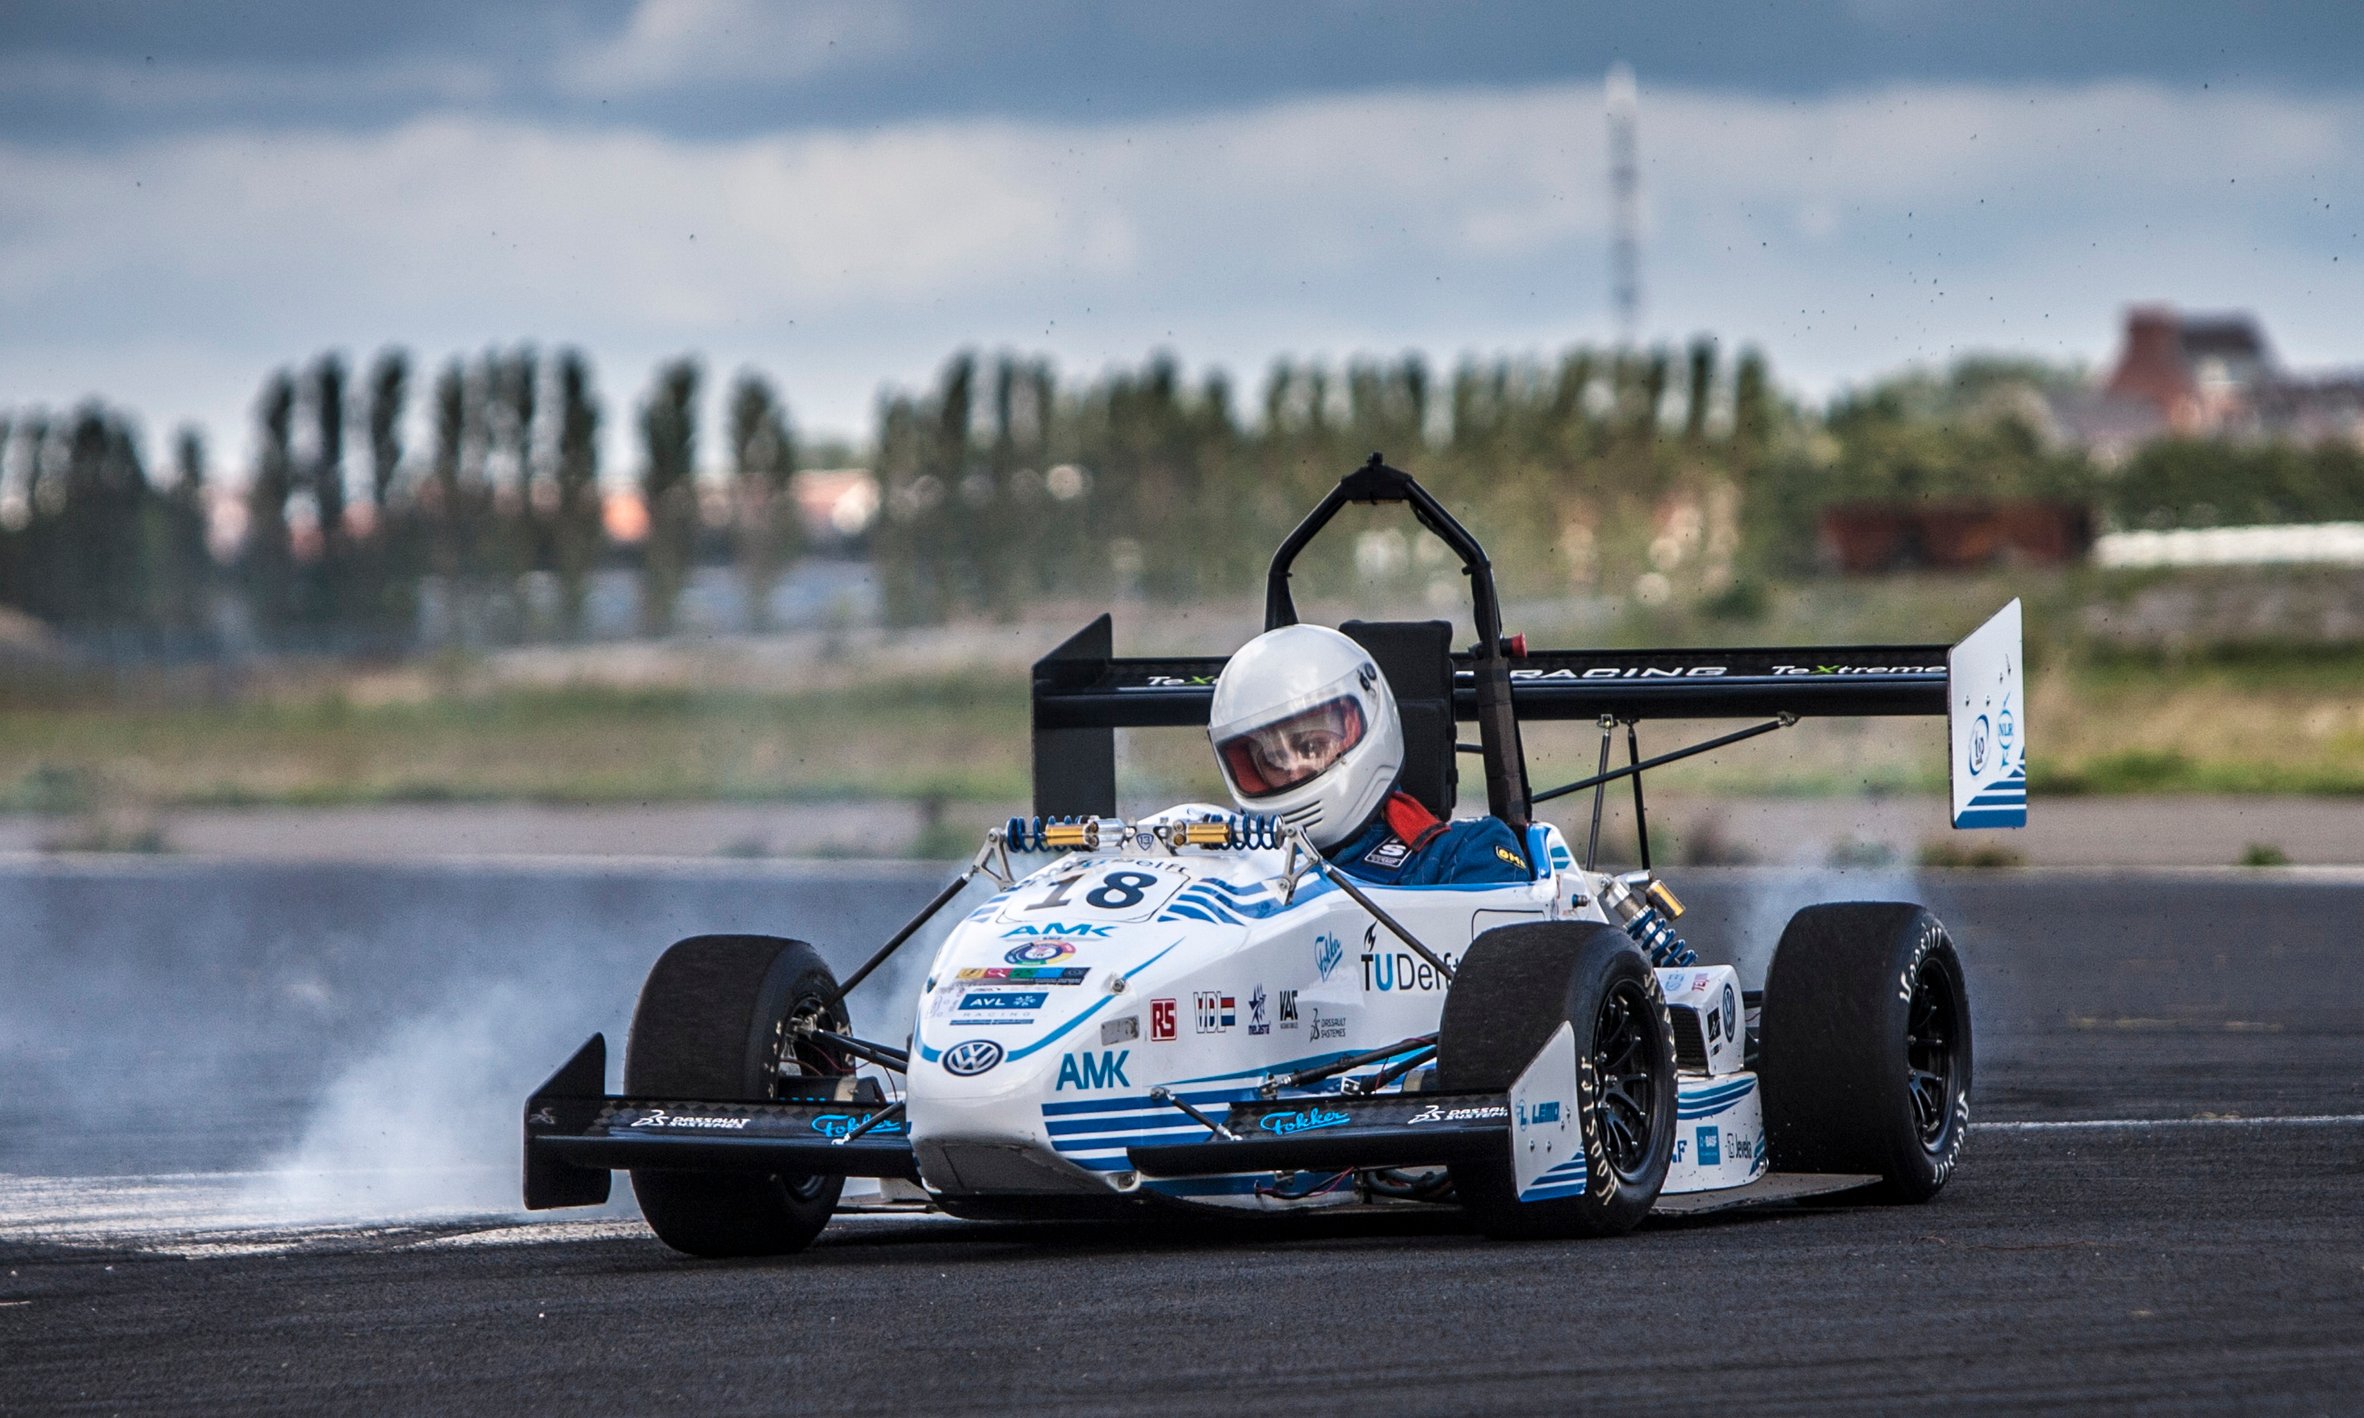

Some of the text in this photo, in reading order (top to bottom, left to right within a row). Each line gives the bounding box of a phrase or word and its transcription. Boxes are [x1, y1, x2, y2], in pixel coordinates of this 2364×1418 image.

[1510, 666, 1727, 679] RACING
[1771, 665, 1947, 675] TeXtreme
[1024, 871, 1158, 911] 18
[1001, 922, 1119, 938] AMK
[969, 998, 1006, 1006] AVL
[1193, 991, 1226, 1034] VDL
[1152, 1001, 1175, 1038] RS
[1056, 1050, 1131, 1091] AMK
[1260, 1107, 1350, 1135] Fokker
